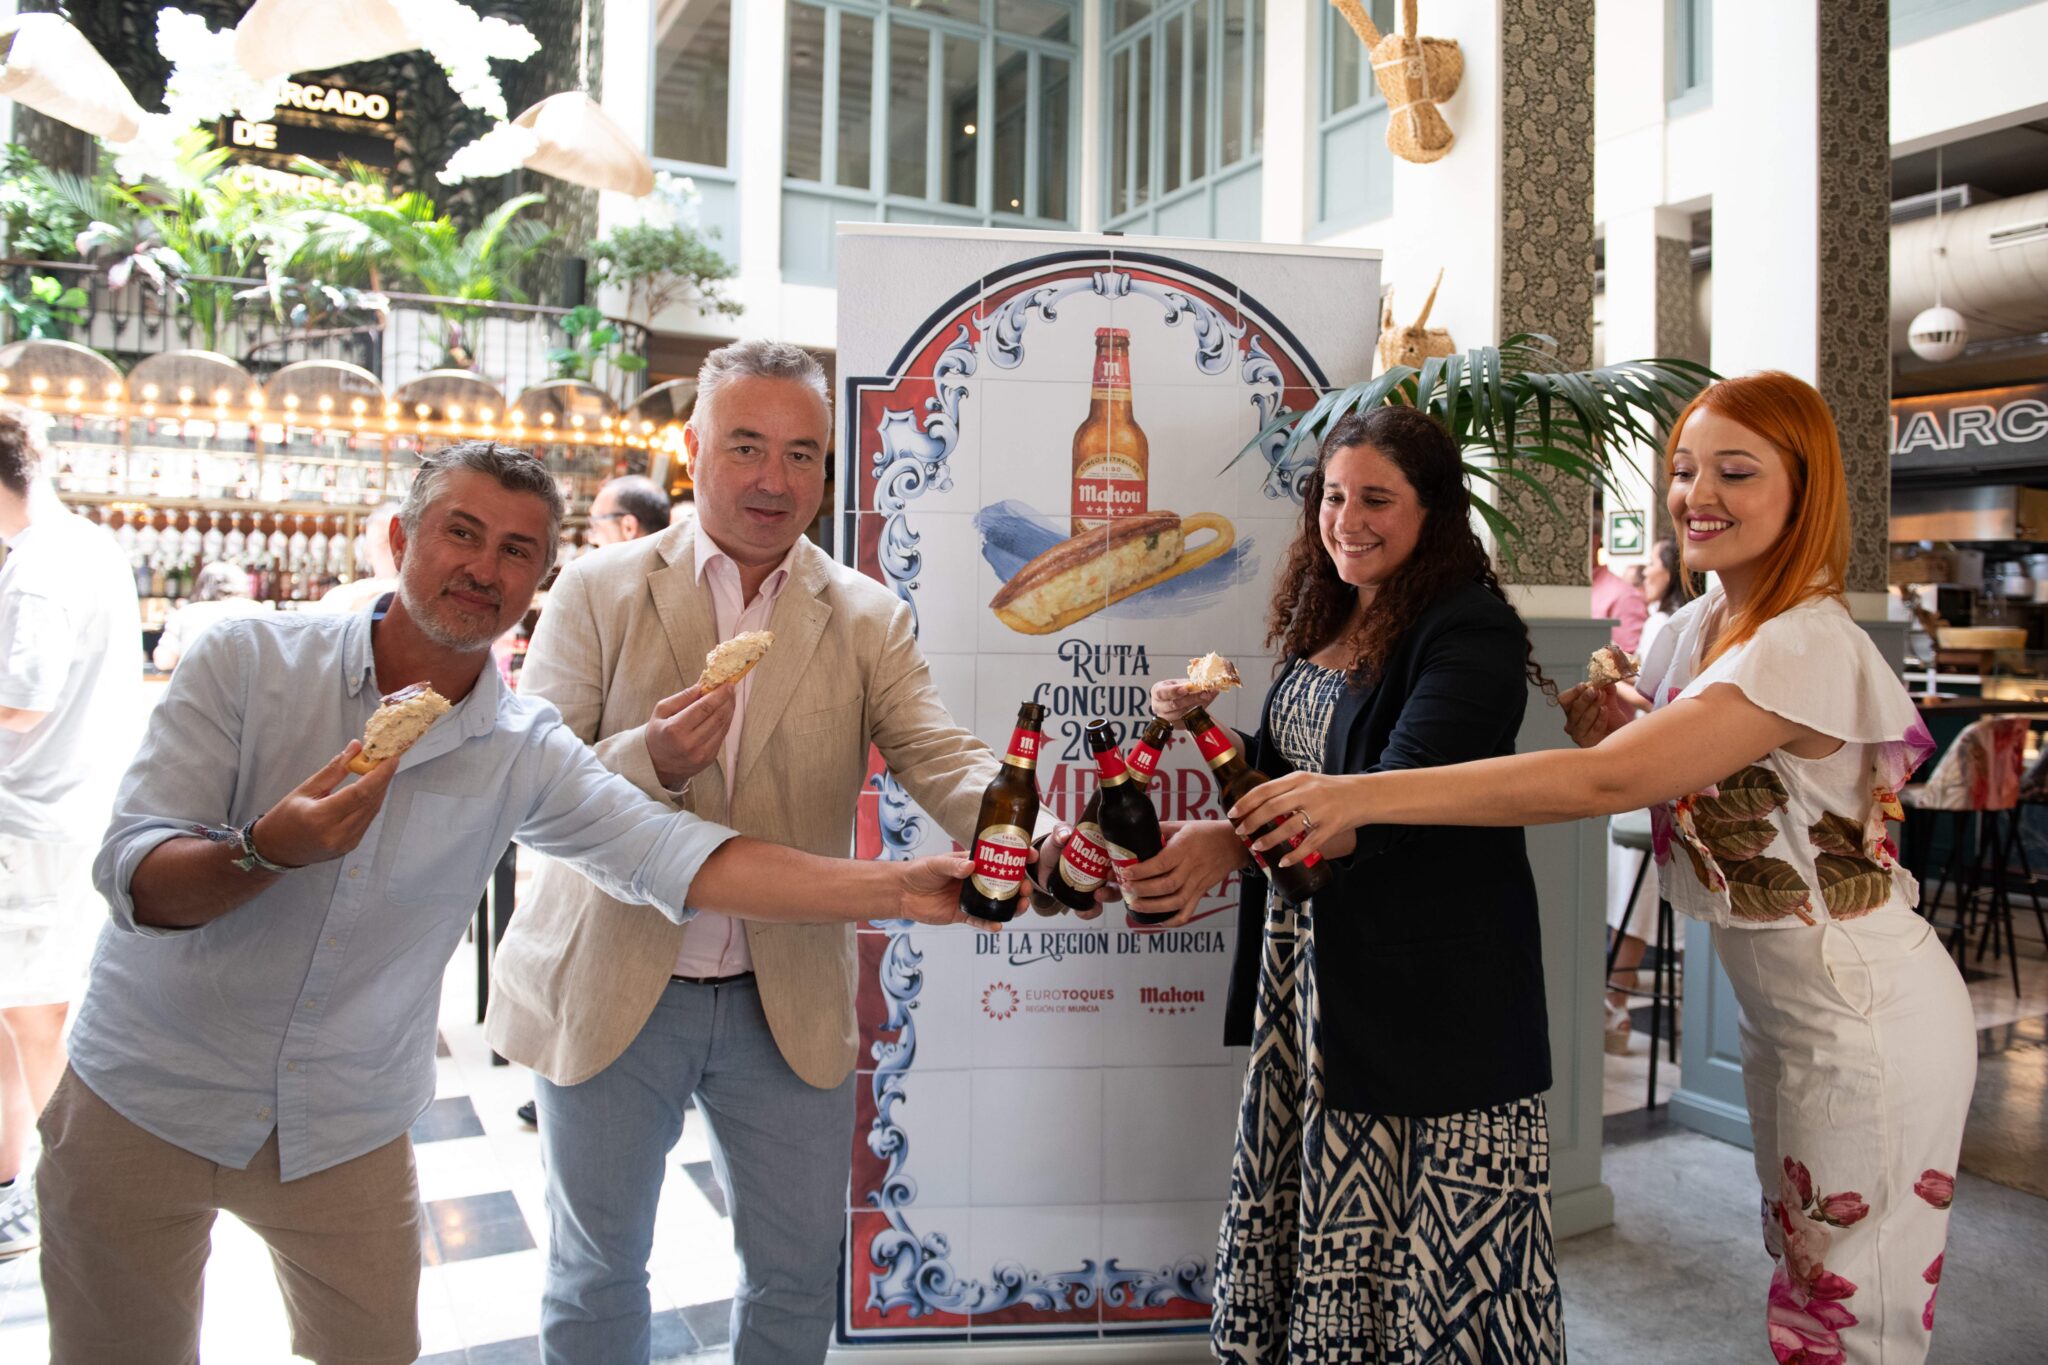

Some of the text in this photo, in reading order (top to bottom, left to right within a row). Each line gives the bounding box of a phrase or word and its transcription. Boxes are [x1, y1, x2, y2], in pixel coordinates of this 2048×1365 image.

[279, 82, 389, 120] RCADO
[232, 120, 278, 149] DE
[1890, 399, 2048, 455] ARC
[1079, 484, 1141, 503] Mahou
[1058, 639, 1149, 683] RUTA
[1033, 683, 1155, 718] CONCUR
[1061, 721, 1152, 761] 22
[1036, 764, 1218, 822] MEOR
[980, 845, 1027, 867] Mahou
[1071, 835, 1112, 867] Mahou
[976, 933, 1000, 955] DE
[1008, 933, 1032, 955] LA
[1117, 932, 1141, 954] DE
[1149, 931, 1225, 954] MURCIA
[1025, 989, 1115, 1002] EUROTOQUES
[1056, 1005, 1067, 1013] DE
[1068, 1004, 1100, 1013] MURCIA
[1140, 986, 1205, 1003] Mahou
